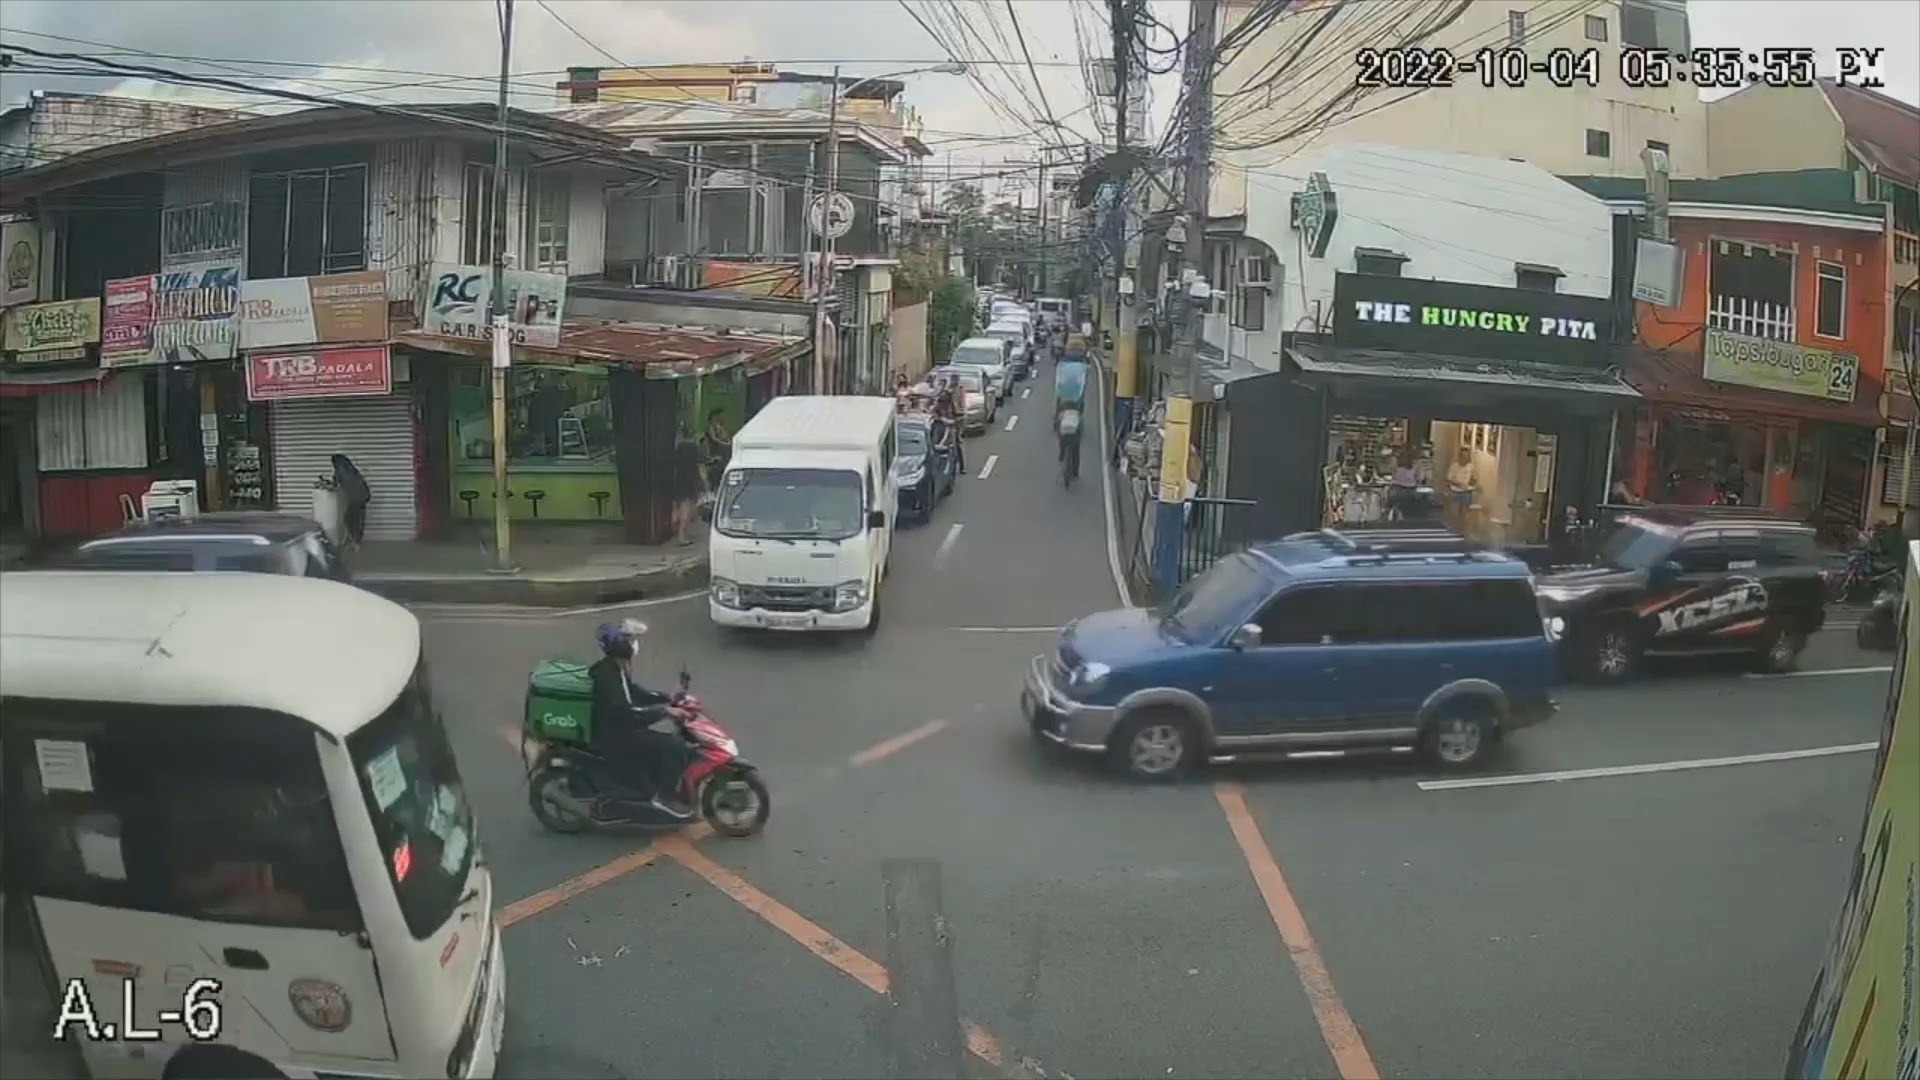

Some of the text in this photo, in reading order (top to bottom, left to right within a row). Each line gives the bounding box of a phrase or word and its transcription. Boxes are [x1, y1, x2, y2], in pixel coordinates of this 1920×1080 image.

[432, 272, 482, 309] RC
[1356, 301, 1597, 340] THE HUNGRY PITA
[261, 355, 373, 380] TRB PADALA
[1831, 365, 1853, 391] 24
[544, 713, 577, 727] Grab
